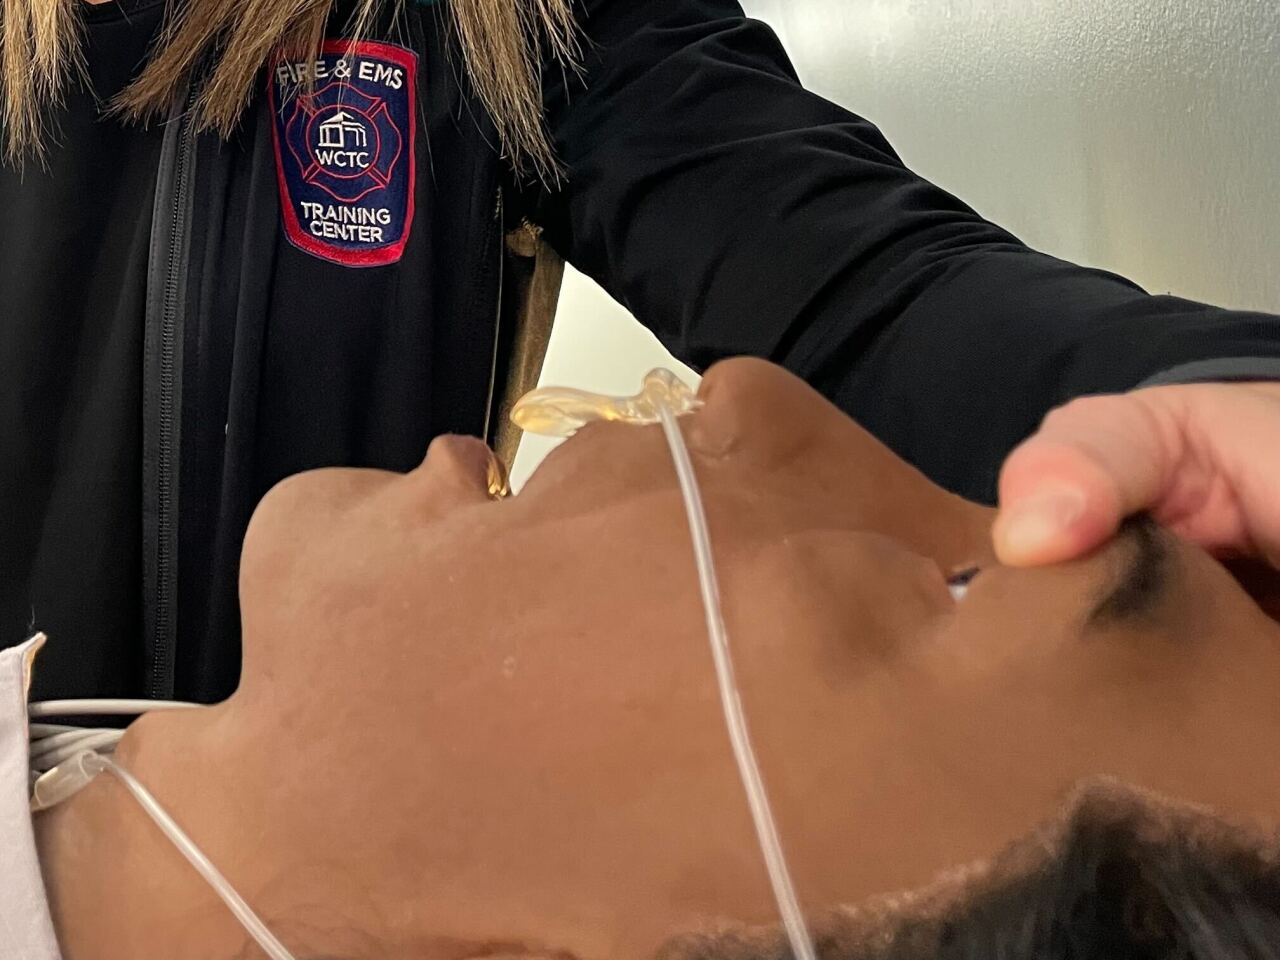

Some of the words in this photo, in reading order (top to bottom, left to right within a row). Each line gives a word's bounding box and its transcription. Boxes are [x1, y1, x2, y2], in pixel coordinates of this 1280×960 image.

[335, 59, 351, 78] &
[358, 61, 403, 89] EMS
[316, 149, 369, 167] WCTC
[300, 201, 391, 224] TRAINING
[309, 220, 384, 242] CENTER
